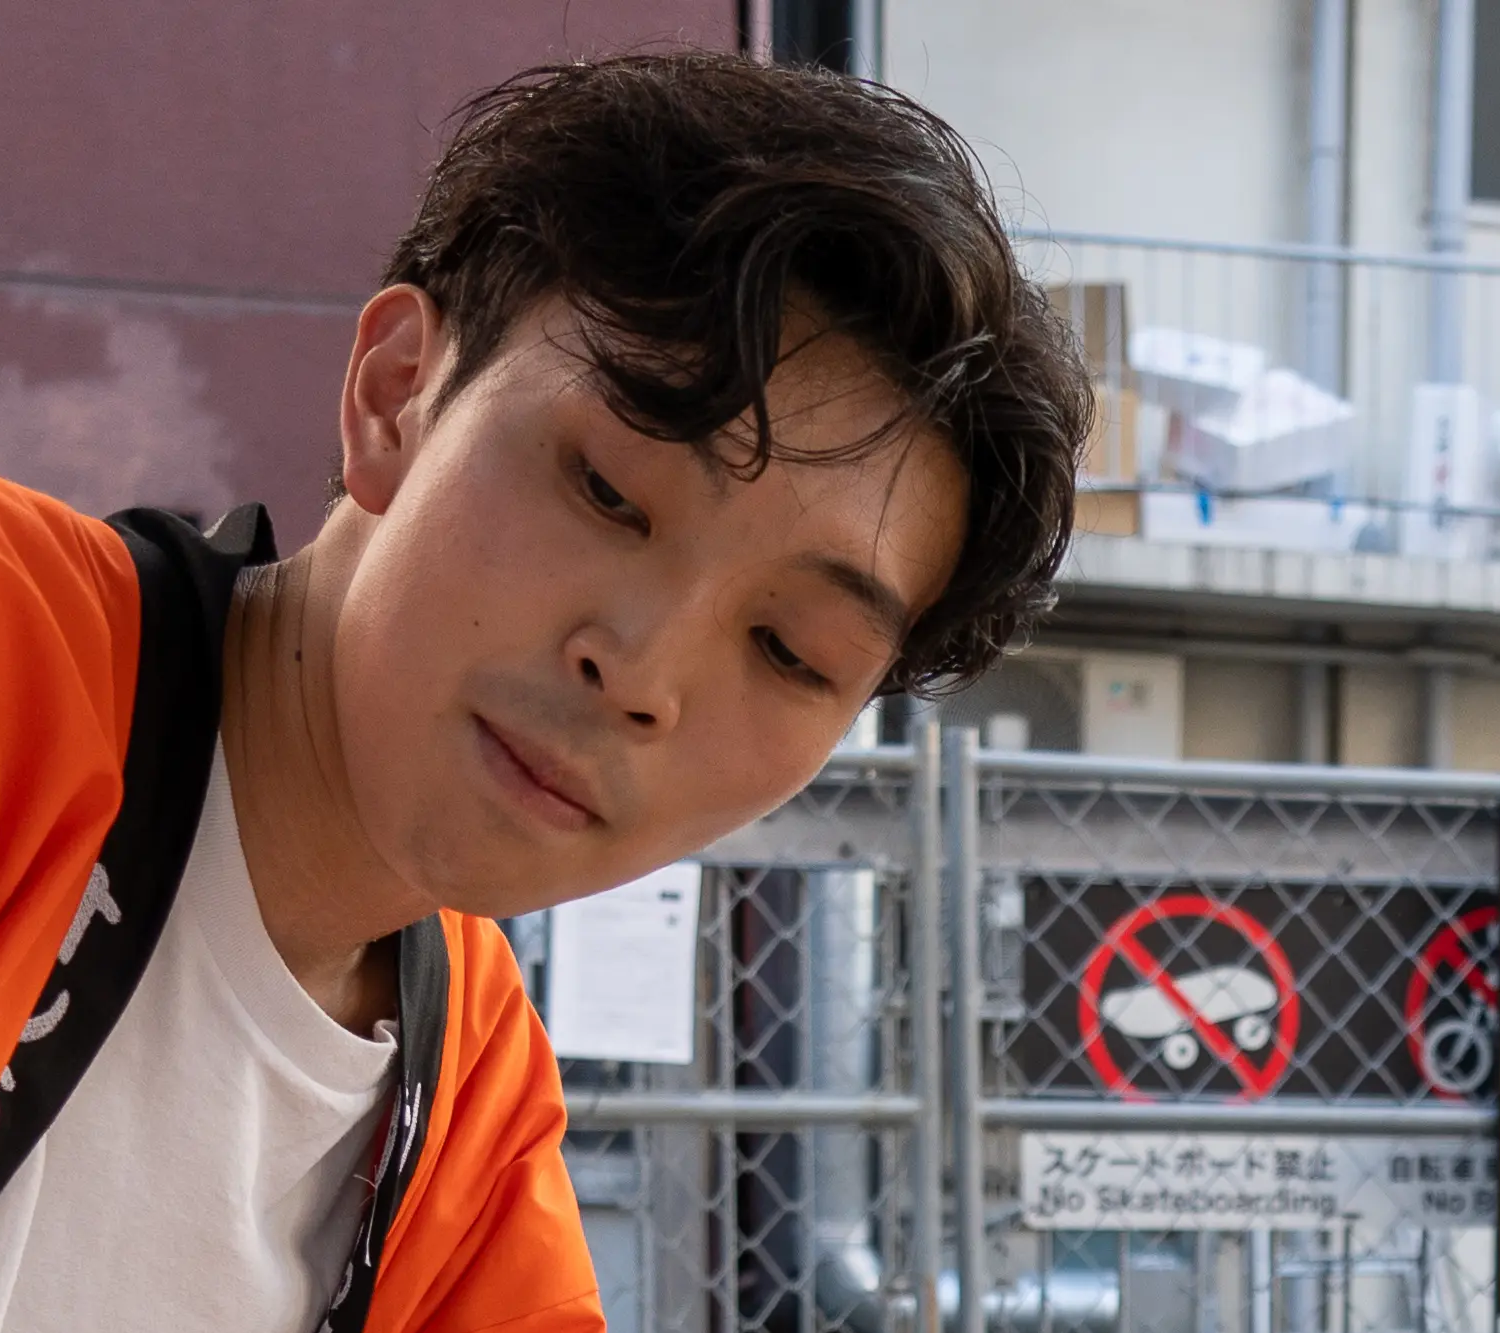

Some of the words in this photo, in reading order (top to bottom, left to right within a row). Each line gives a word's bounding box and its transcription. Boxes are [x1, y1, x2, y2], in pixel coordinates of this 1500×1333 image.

[1044, 1145, 1336, 1181] スケートボード禁止
[1039, 1185, 1085, 1213] No
[1095, 1185, 1338, 1218] Skateboarding
